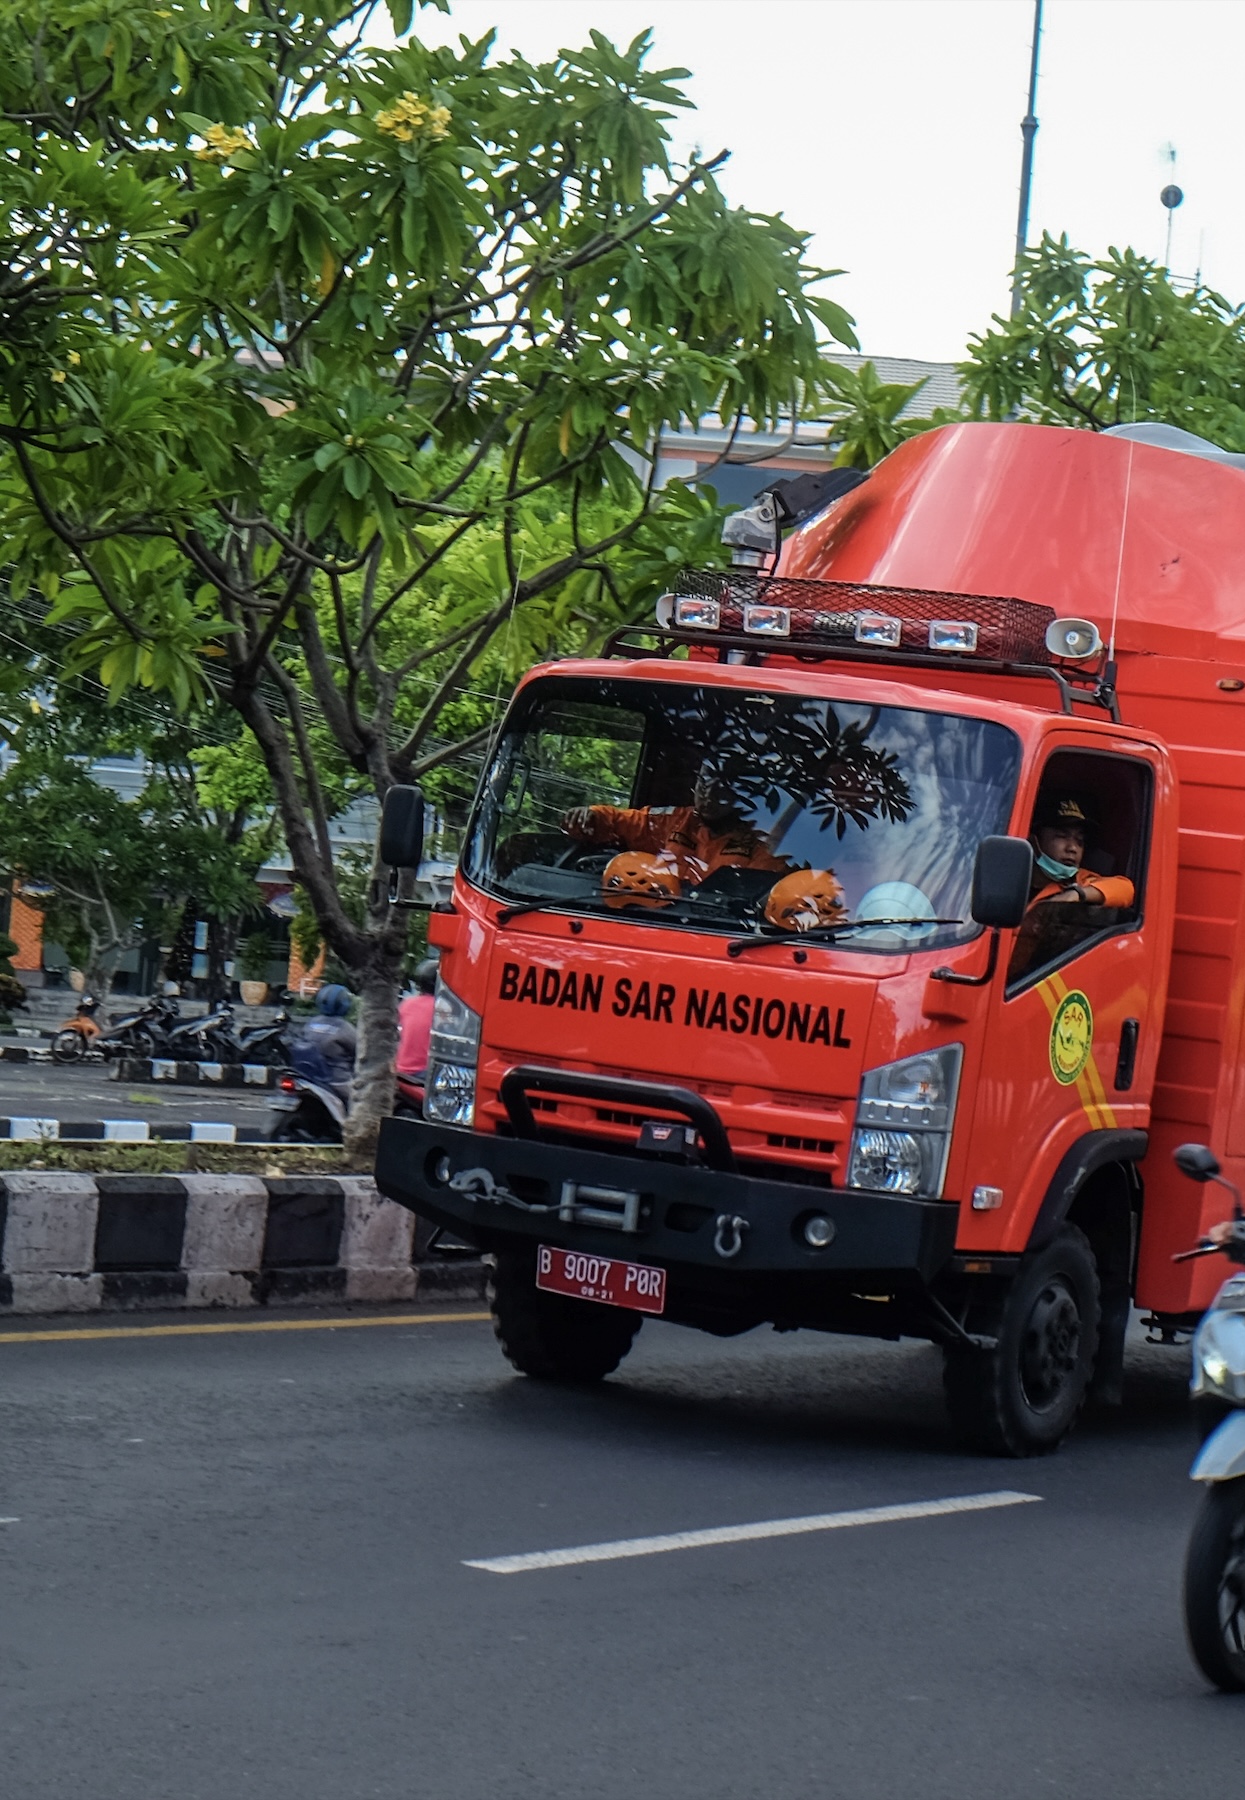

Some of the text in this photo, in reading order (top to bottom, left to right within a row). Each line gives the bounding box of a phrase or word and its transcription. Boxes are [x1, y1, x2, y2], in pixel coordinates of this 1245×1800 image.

[499, 962, 851, 1049] BADAN SAR NASIONAL
[1063, 1006, 1084, 1028] SAR
[541, 1249, 552, 1274] B
[564, 1255, 611, 1286] 9007
